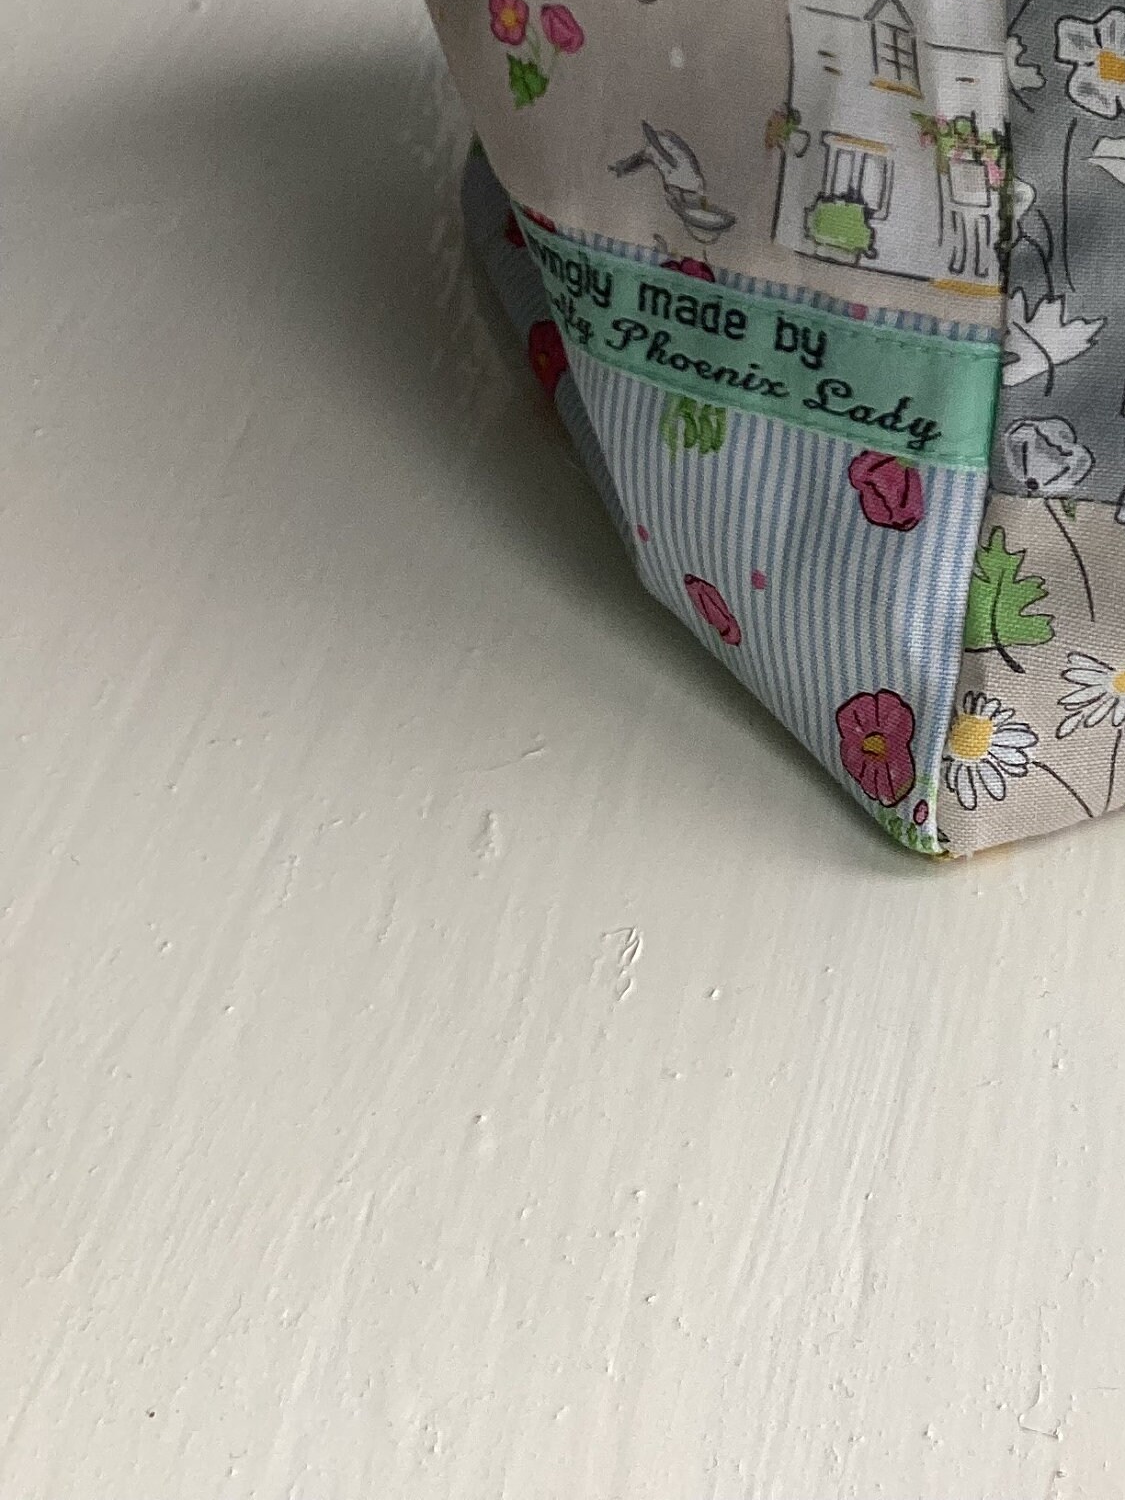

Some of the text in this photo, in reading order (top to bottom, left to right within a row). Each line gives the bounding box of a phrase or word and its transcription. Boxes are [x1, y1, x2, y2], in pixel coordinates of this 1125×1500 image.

[637, 280, 747, 340] made
[774, 315, 829, 370] by
[605, 316, 789, 398] Phoenix
[802, 377, 943, 449] Lady
